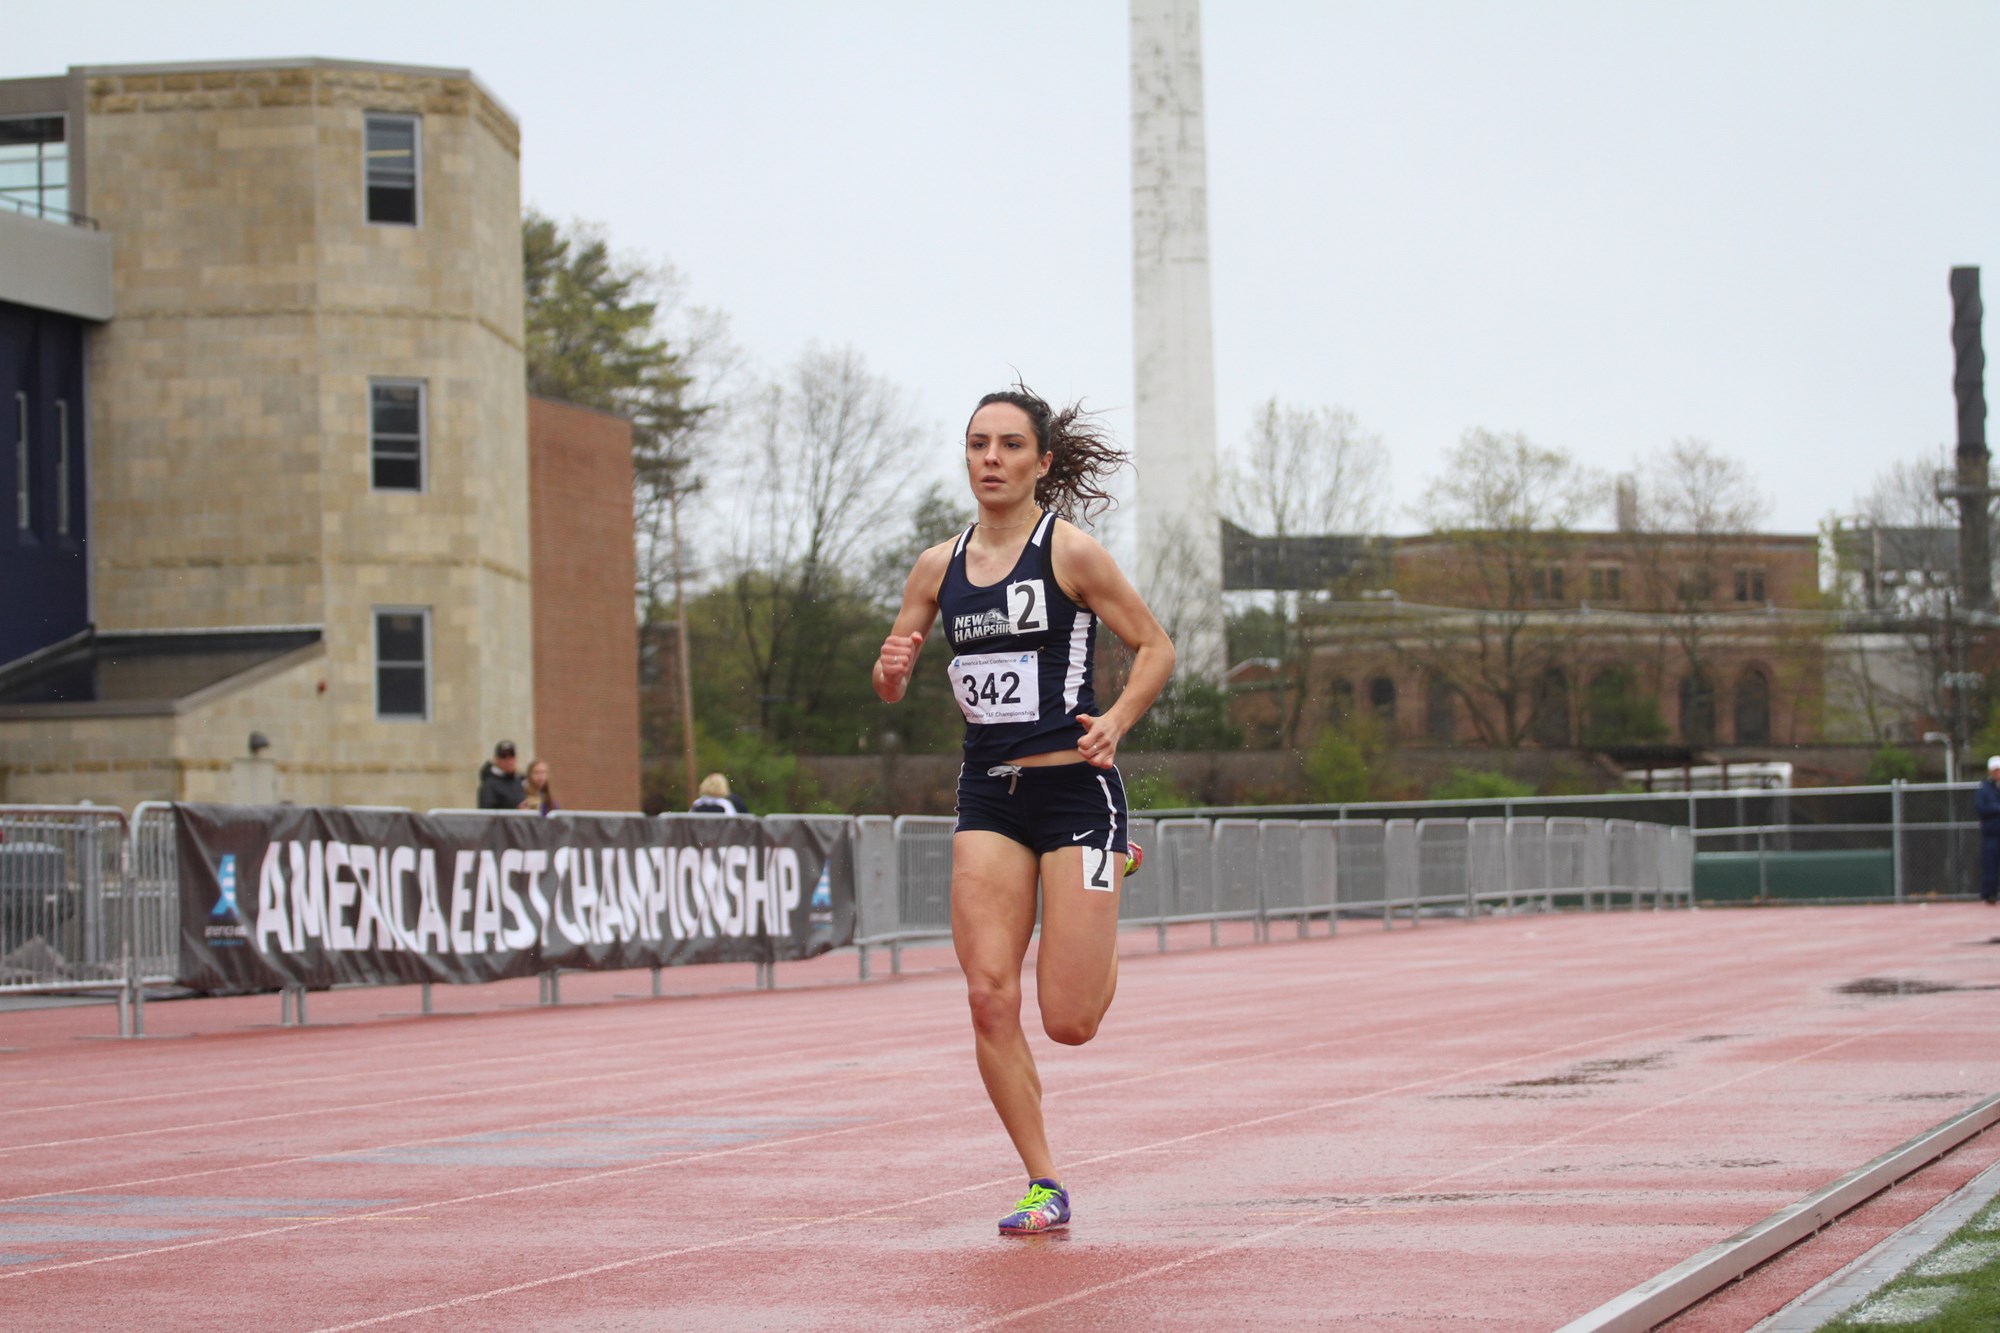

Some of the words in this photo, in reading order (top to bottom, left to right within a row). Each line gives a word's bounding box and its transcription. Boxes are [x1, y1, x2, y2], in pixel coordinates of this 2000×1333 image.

[954, 614, 984, 630] NEW
[1014, 584, 1040, 631] 2
[954, 623, 1012, 643] HAMPSHIR
[962, 671, 1021, 707] 342
[1091, 848, 1109, 888] 2
[256, 840, 450, 955] AMERICA
[451, 849, 549, 955] EAST
[554, 846, 801, 946] CHAMPIONSHIP
